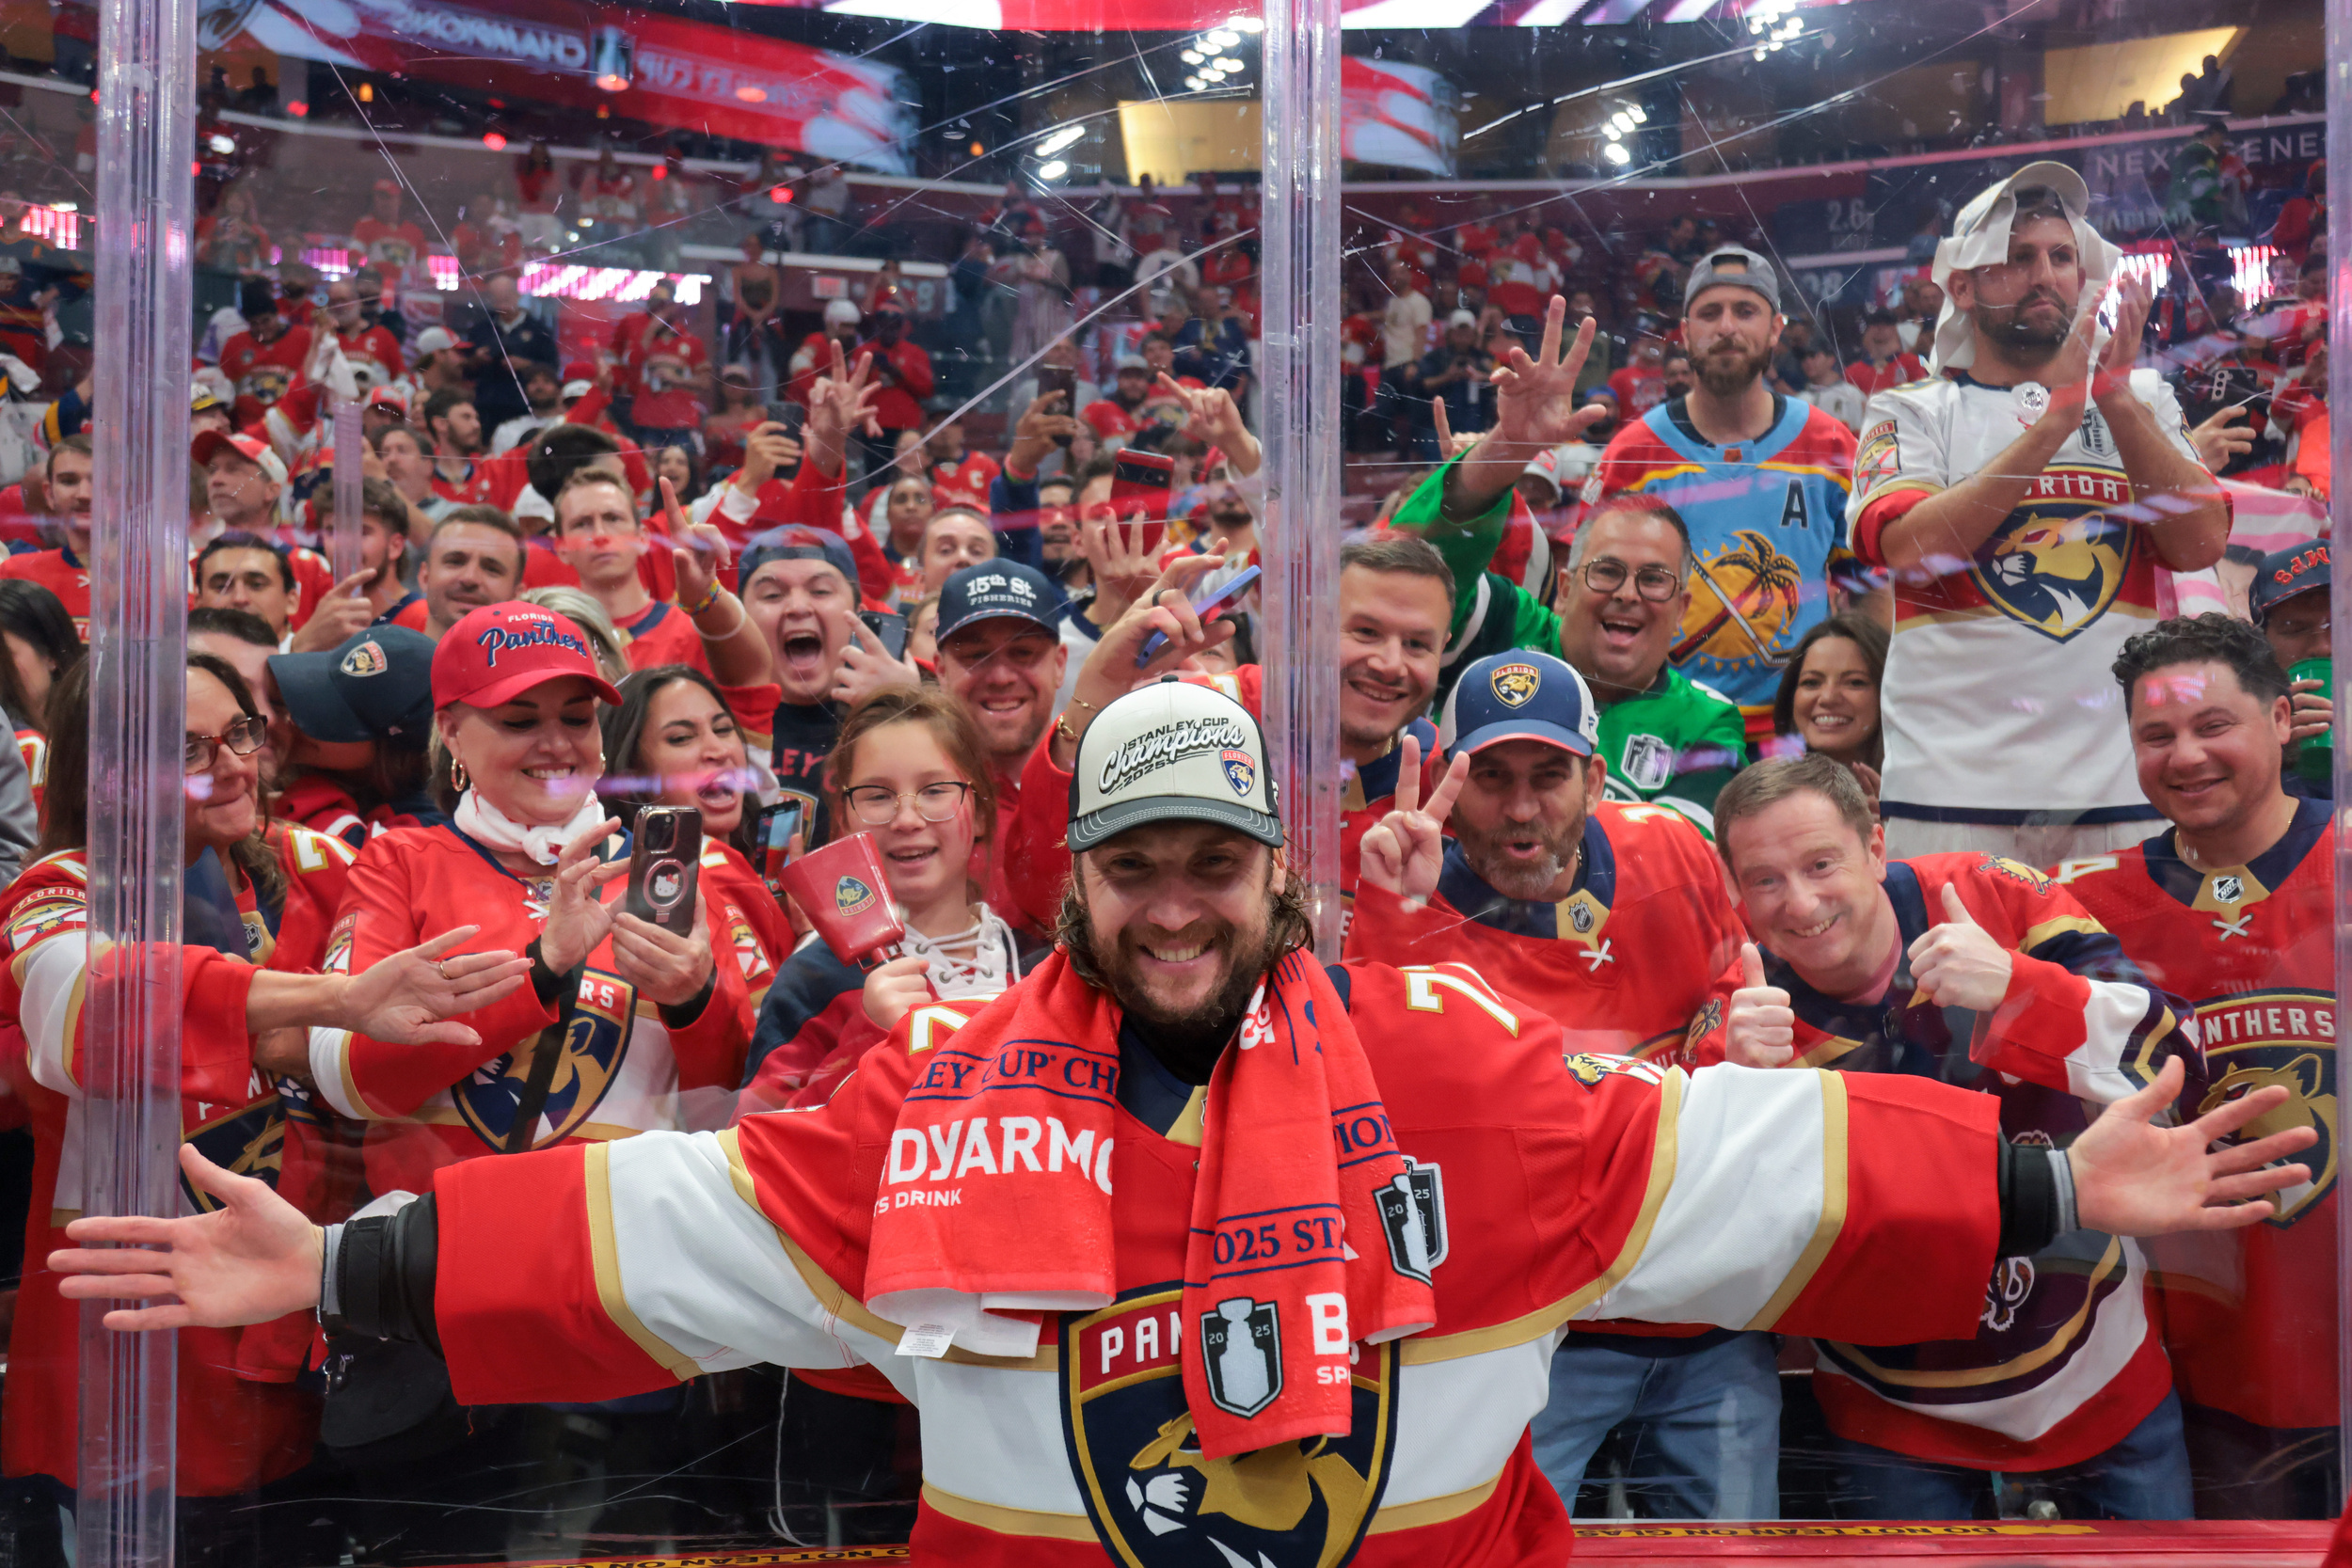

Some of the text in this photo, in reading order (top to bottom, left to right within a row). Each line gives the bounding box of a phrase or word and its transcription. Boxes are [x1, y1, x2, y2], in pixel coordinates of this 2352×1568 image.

[2095, 149, 2173, 179] NEX
[2026, 474, 2119, 502] RIDA
[1780, 478, 1809, 530] A
[2274, 546, 2331, 586] MPS
[966, 574, 1037, 600] 15th St.
[969, 594, 1033, 608] FISHERIES
[508, 613, 554, 623] FLORIDA
[477, 621, 587, 668] Panthers
[1496, 666, 1536, 676] FLORIDA
[1128, 717, 1230, 751] STANLEY CUP
[1099, 724, 1246, 795] Champions
[1224, 752, 1253, 764] FLORIDA
[1124, 758, 1166, 788] 2025
[2220, 881, 2237, 899] NHL
[2204, 1008, 2335, 1045] NTHERS
[881, 1116, 1114, 1196] DYARM
[895, 1188, 962, 1210] DRINK
[1414, 1189, 1430, 1199] 25
[1387, 1204, 1404, 1218] 20
[1214, 1224, 1280, 1265] 025
[1208, 1323, 1271, 1345] 20 25
